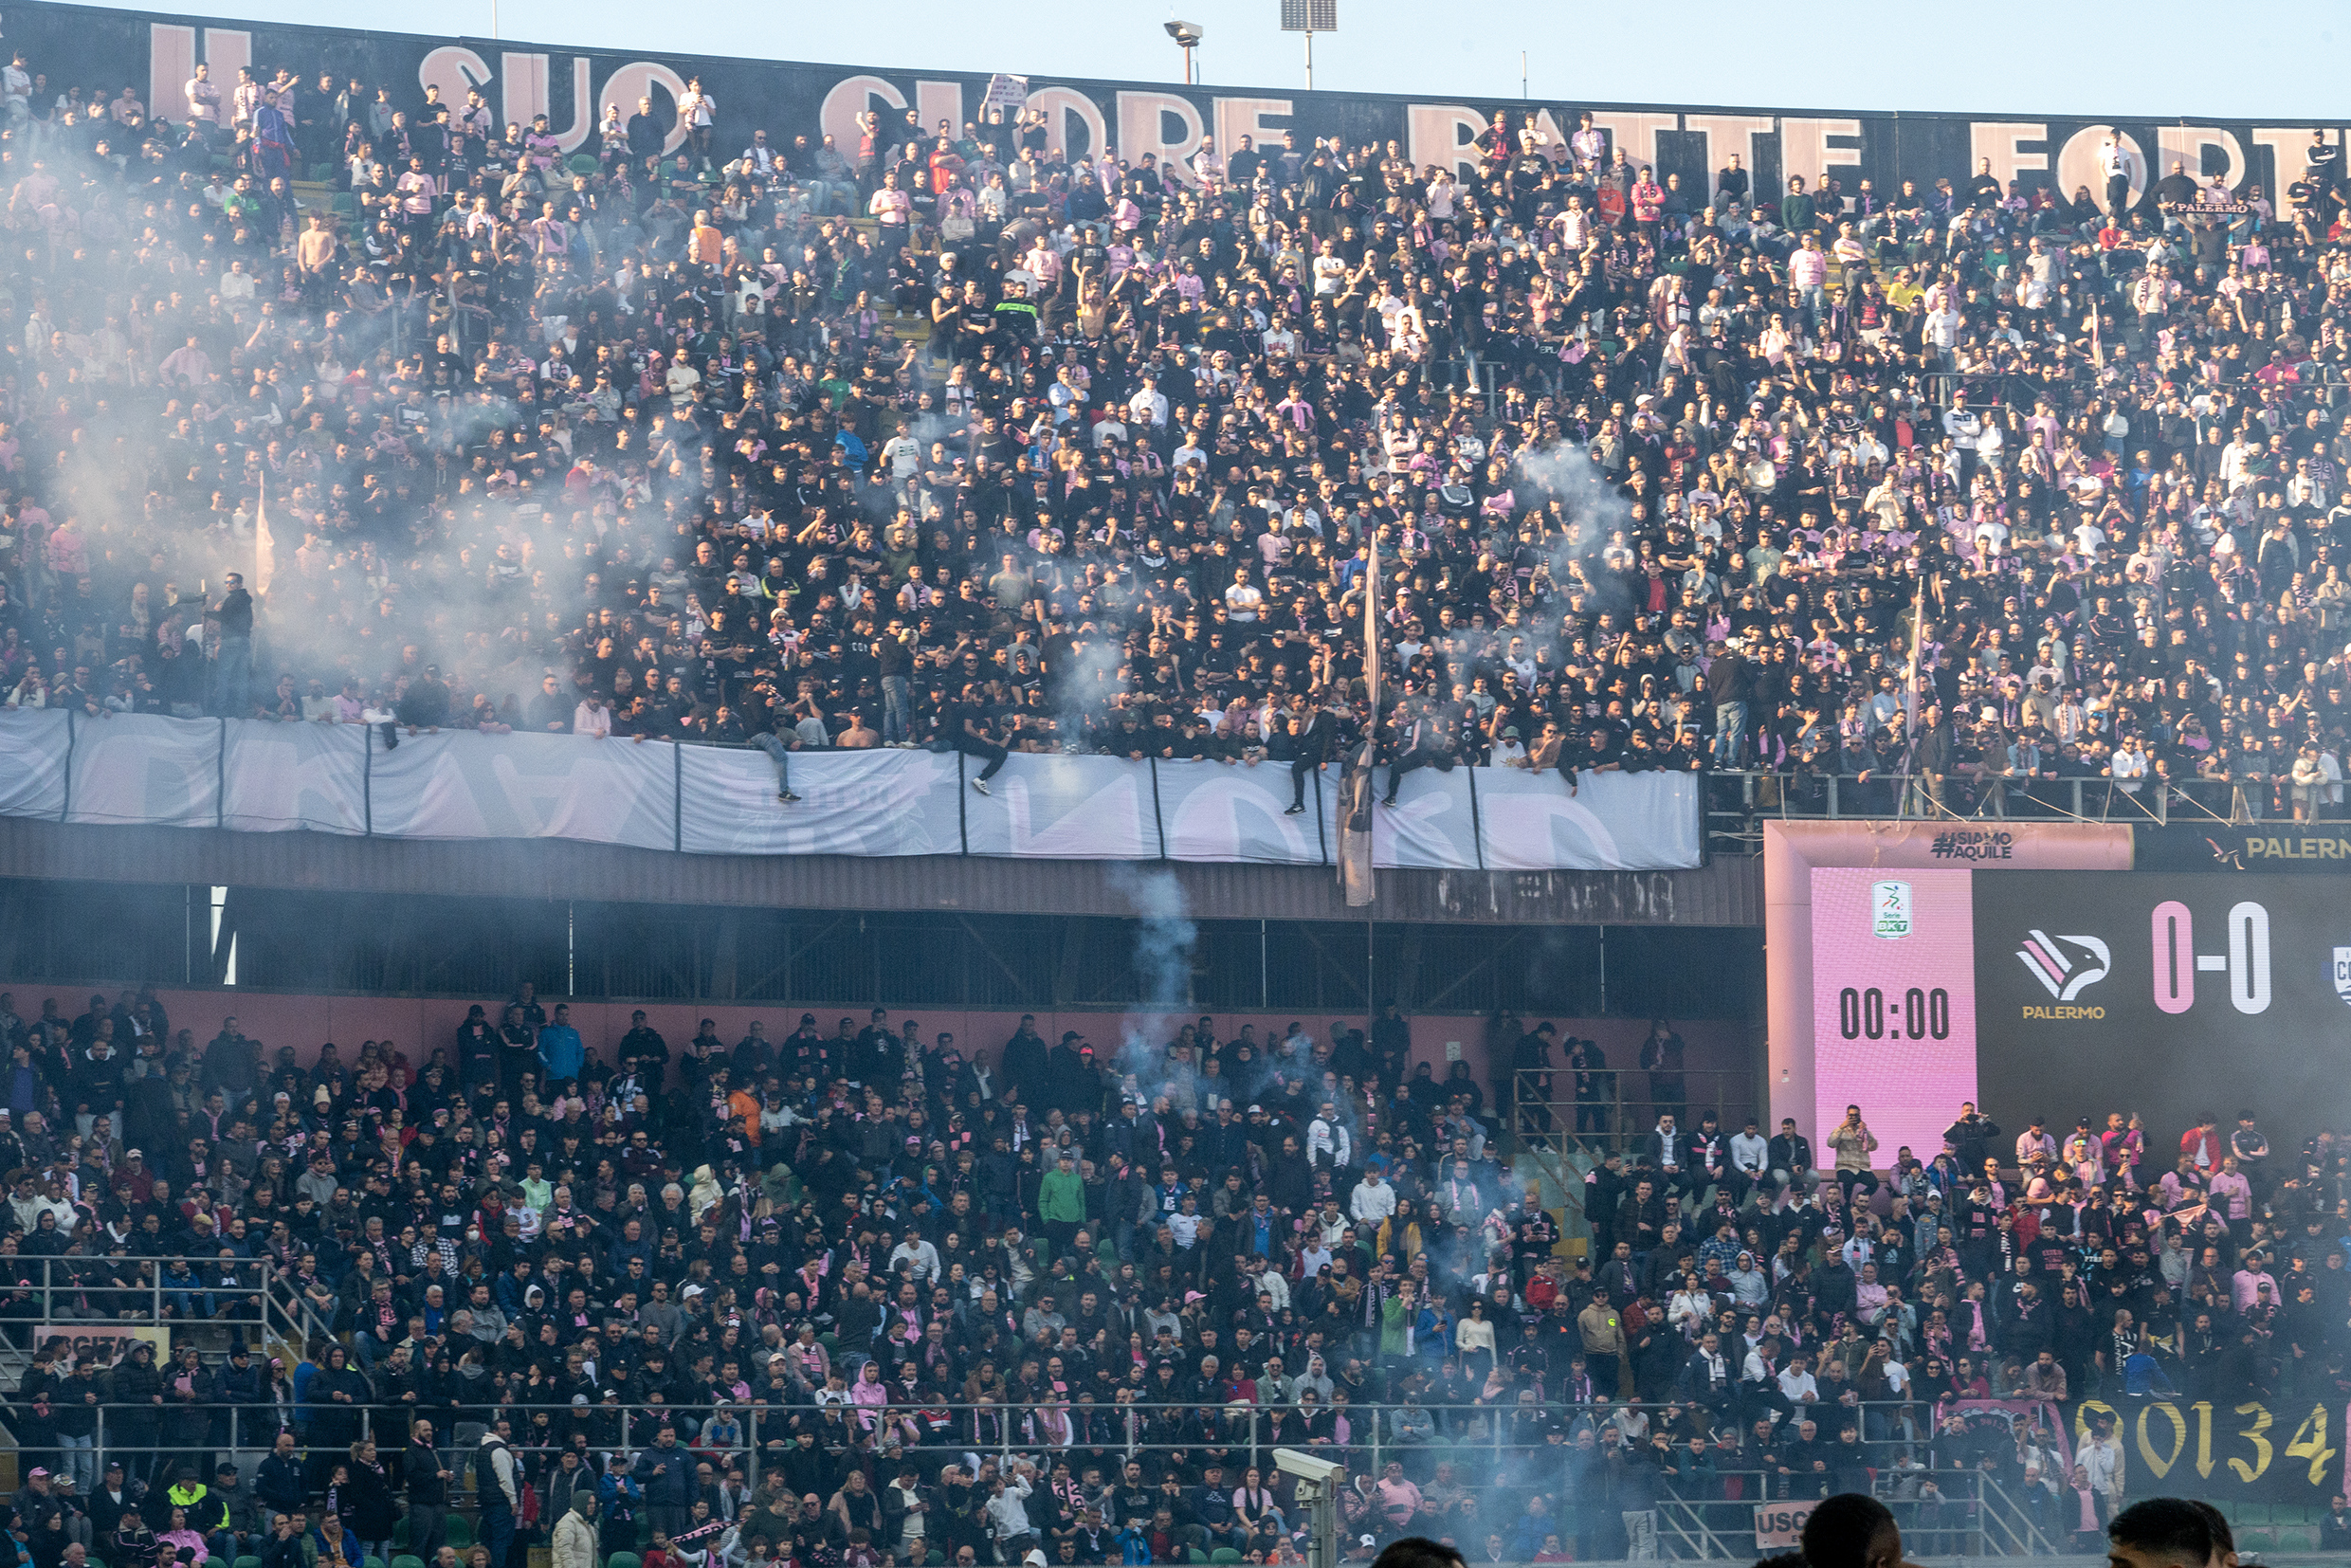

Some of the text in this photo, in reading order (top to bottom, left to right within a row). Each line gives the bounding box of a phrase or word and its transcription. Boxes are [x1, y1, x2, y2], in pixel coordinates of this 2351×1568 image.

[418, 46, 689, 157] SUO
[1408, 104, 1861, 212] BATTE
[1970, 122, 2351, 223] FORT
[2177, 203, 2249, 213] PALERMO
[1954, 846, 2012, 861] AQUILE
[1878, 921, 1907, 932] BKT
[1840, 988, 1949, 1040] 00:00
[2021, 1006, 2105, 1019] PALERMO
[1758, 1510, 1813, 1534] USC
